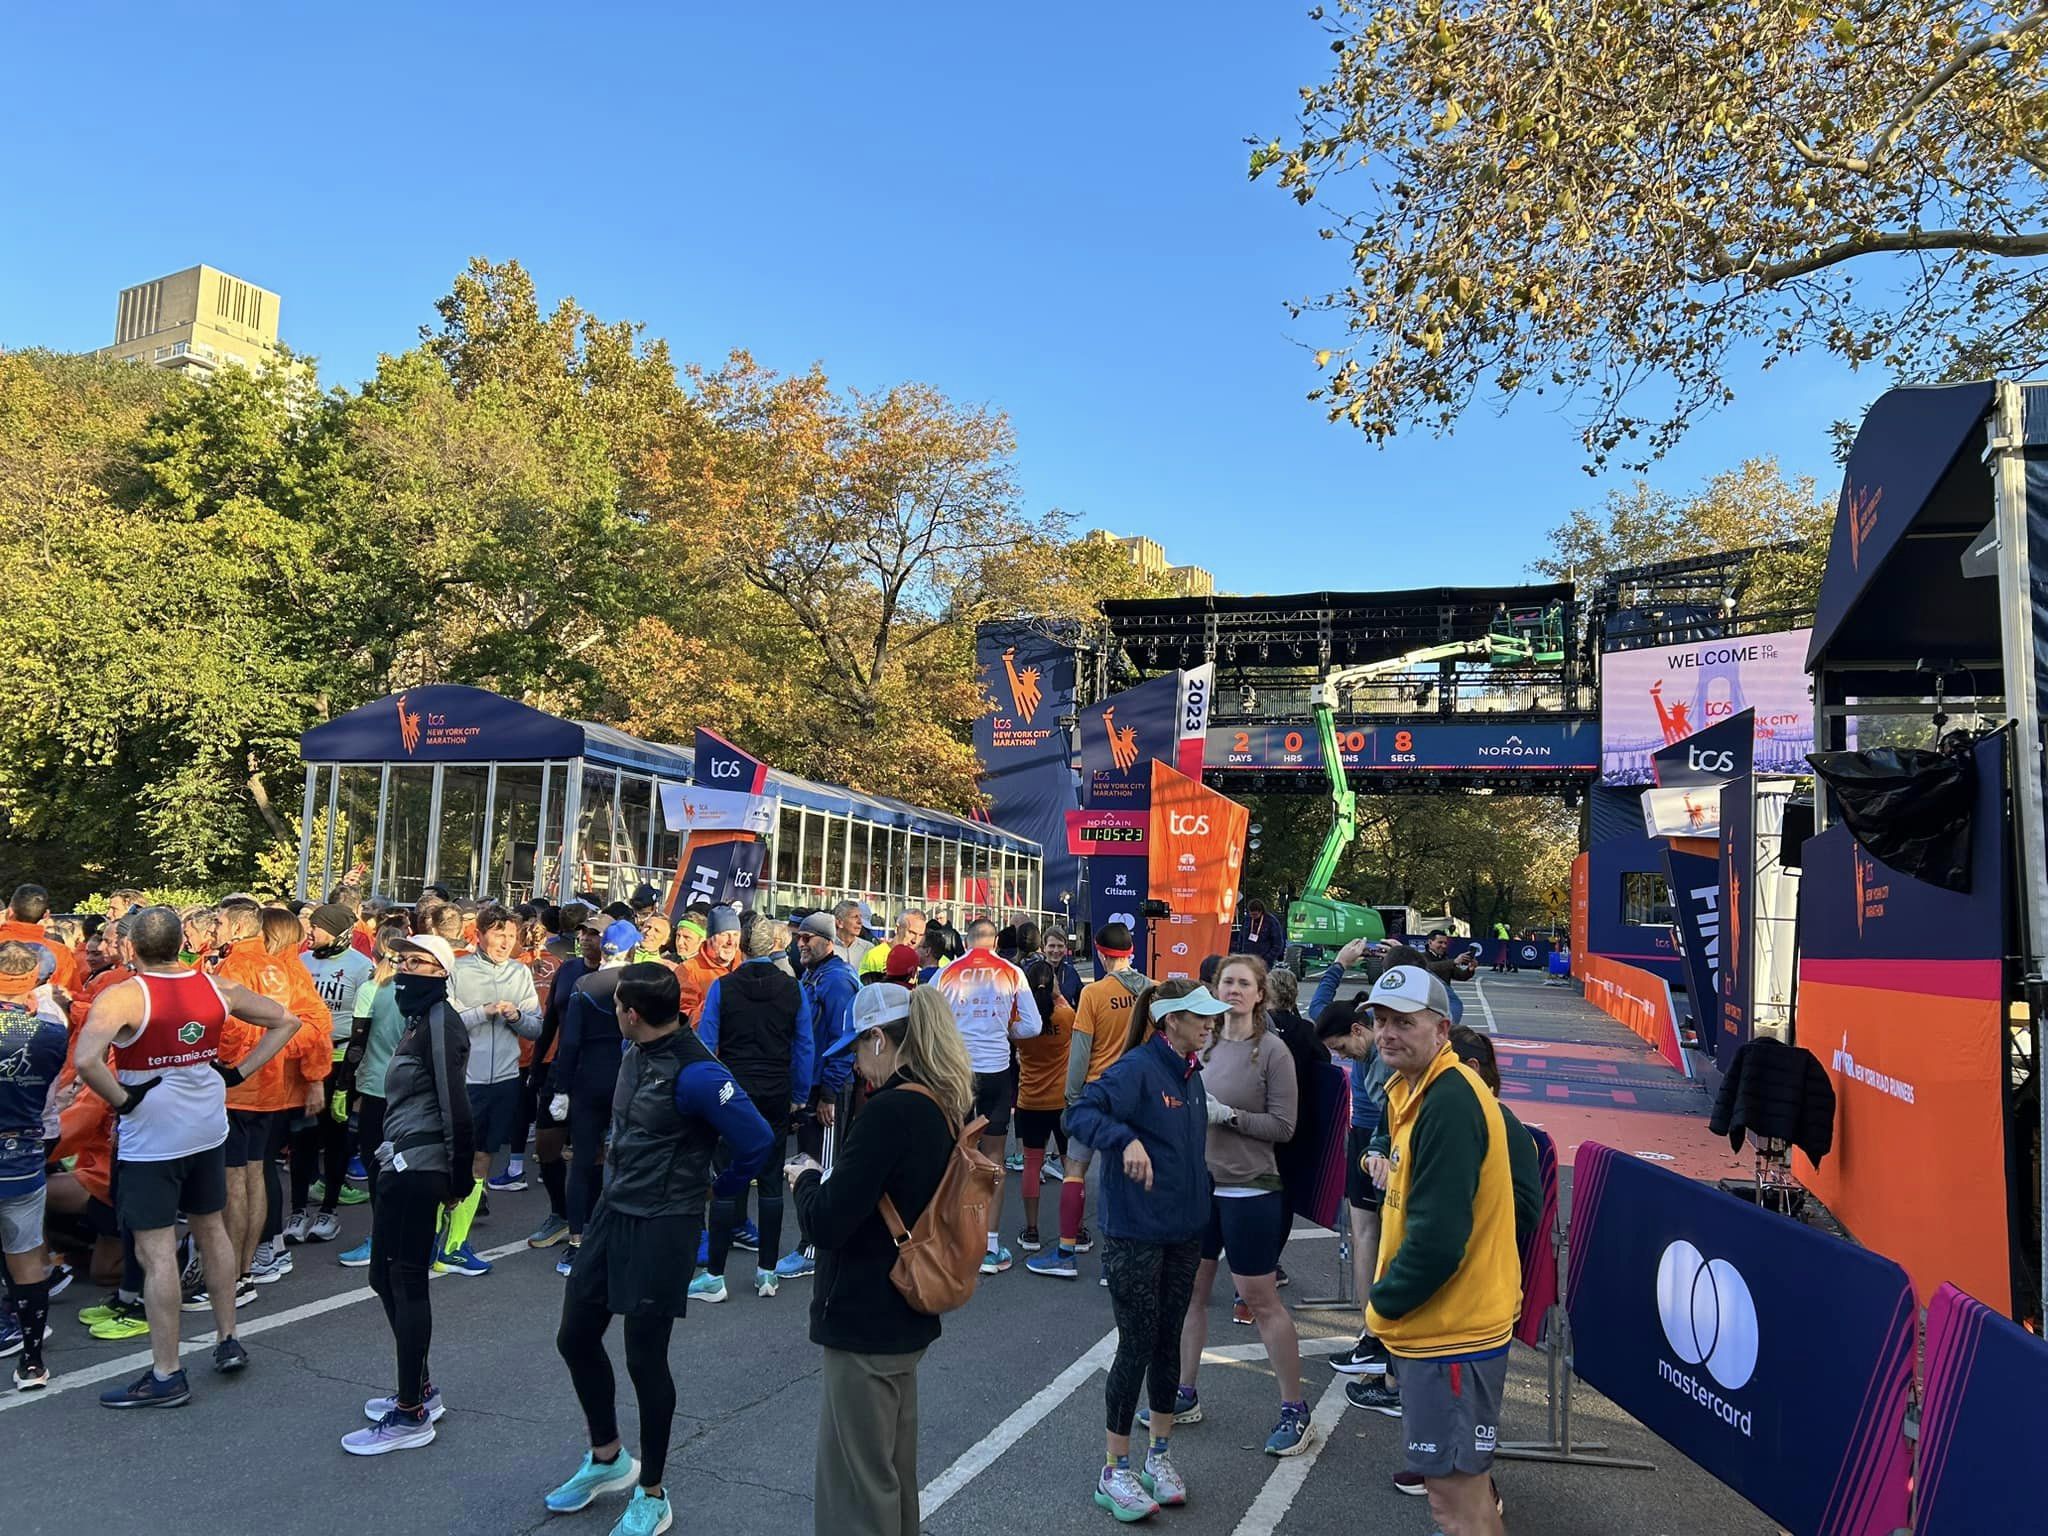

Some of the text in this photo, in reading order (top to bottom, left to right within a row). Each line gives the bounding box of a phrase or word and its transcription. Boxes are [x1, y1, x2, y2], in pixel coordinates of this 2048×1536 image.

[1667, 645, 1758, 669] WELCOME
[1762, 651, 1778, 659] THE
[1186, 679, 1204, 731] 2023
[1705, 700, 1733, 716] tcs
[993, 716, 1012, 729] tcs
[1770, 714, 1798, 725] CITY
[427, 727, 480, 736] NEW YORK CITY
[1033, 730, 1050, 738] CITY
[426, 737, 466, 745] MARATHON
[1233, 732, 1249, 752] 2
[1284, 731, 1303, 753] 0
[1394, 731, 1413, 753] 8
[1228, 754, 1253, 762] DAYS
[1283, 754, 1303, 762] HRS
[1342, 754, 1359, 762] INS
[1391, 754, 1416, 762] SECS
[1478, 746, 1551, 756] NORQAIN
[1688, 744, 1734, 773] tcs
[711, 757, 740, 778] tcs
[1170, 810, 1209, 835] tcs
[734, 867, 752, 888] tcs
[1105, 887, 1136, 896] Citizens
[960, 968, 1002, 983] CITY
[1658, 1358, 1752, 1438] mastercard
[1475, 1424, 1496, 1439] QB
